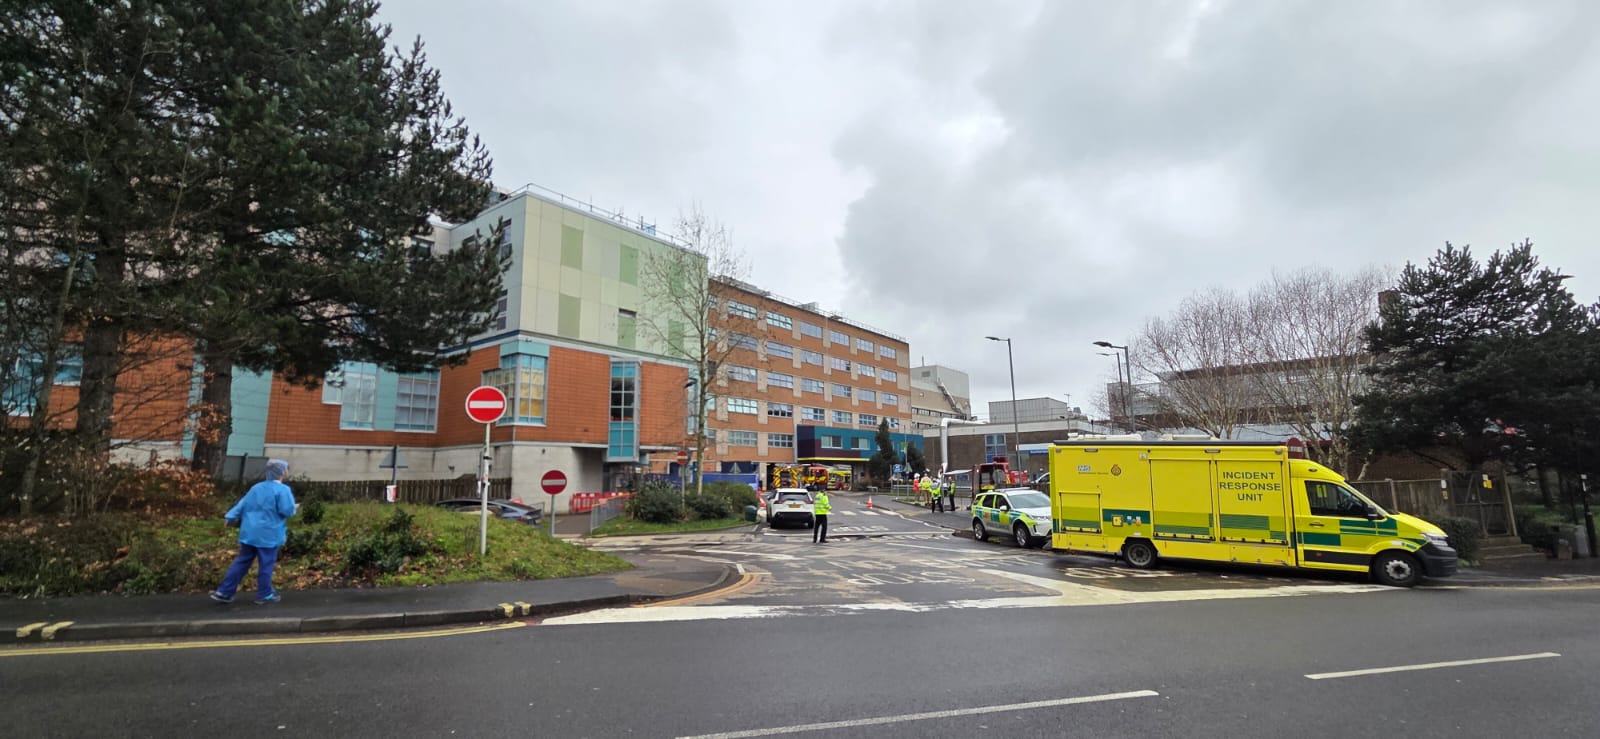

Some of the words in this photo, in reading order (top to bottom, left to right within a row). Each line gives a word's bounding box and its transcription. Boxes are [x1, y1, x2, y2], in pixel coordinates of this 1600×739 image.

[1222, 471, 1276, 480] INCIDENT
[1219, 481, 1281, 491] RESPONSE
[1237, 493, 1264, 502] UNIT
[848, 571, 976, 585] STOP
